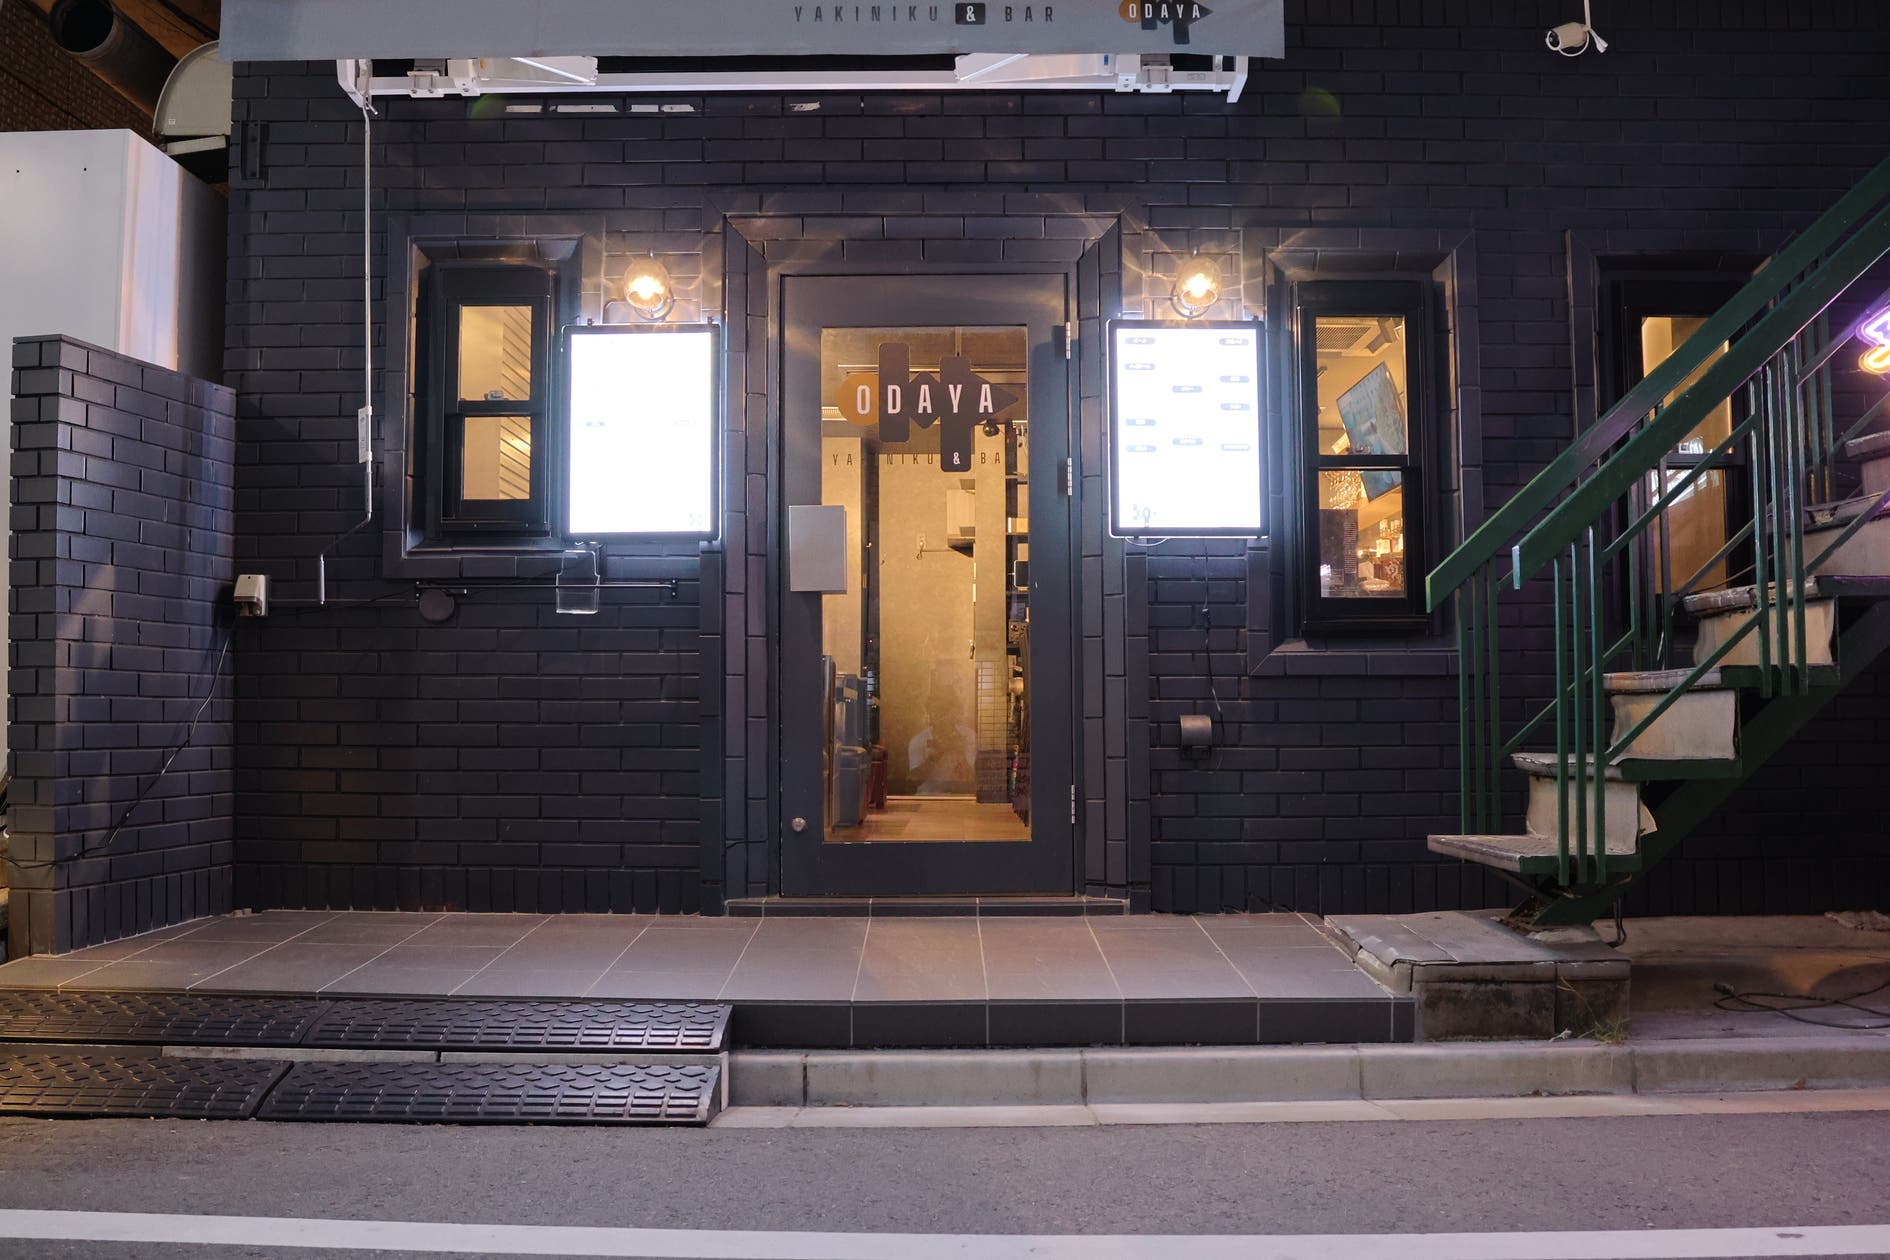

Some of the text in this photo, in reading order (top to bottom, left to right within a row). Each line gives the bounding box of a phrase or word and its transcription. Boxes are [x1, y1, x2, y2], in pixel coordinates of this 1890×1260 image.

[794, 5, 1053, 22] YAKINIKU & BAR
[1129, 3, 1200, 18] ODAYA
[856, 383, 993, 415] ODAYA
[952, 452, 961, 465] &
